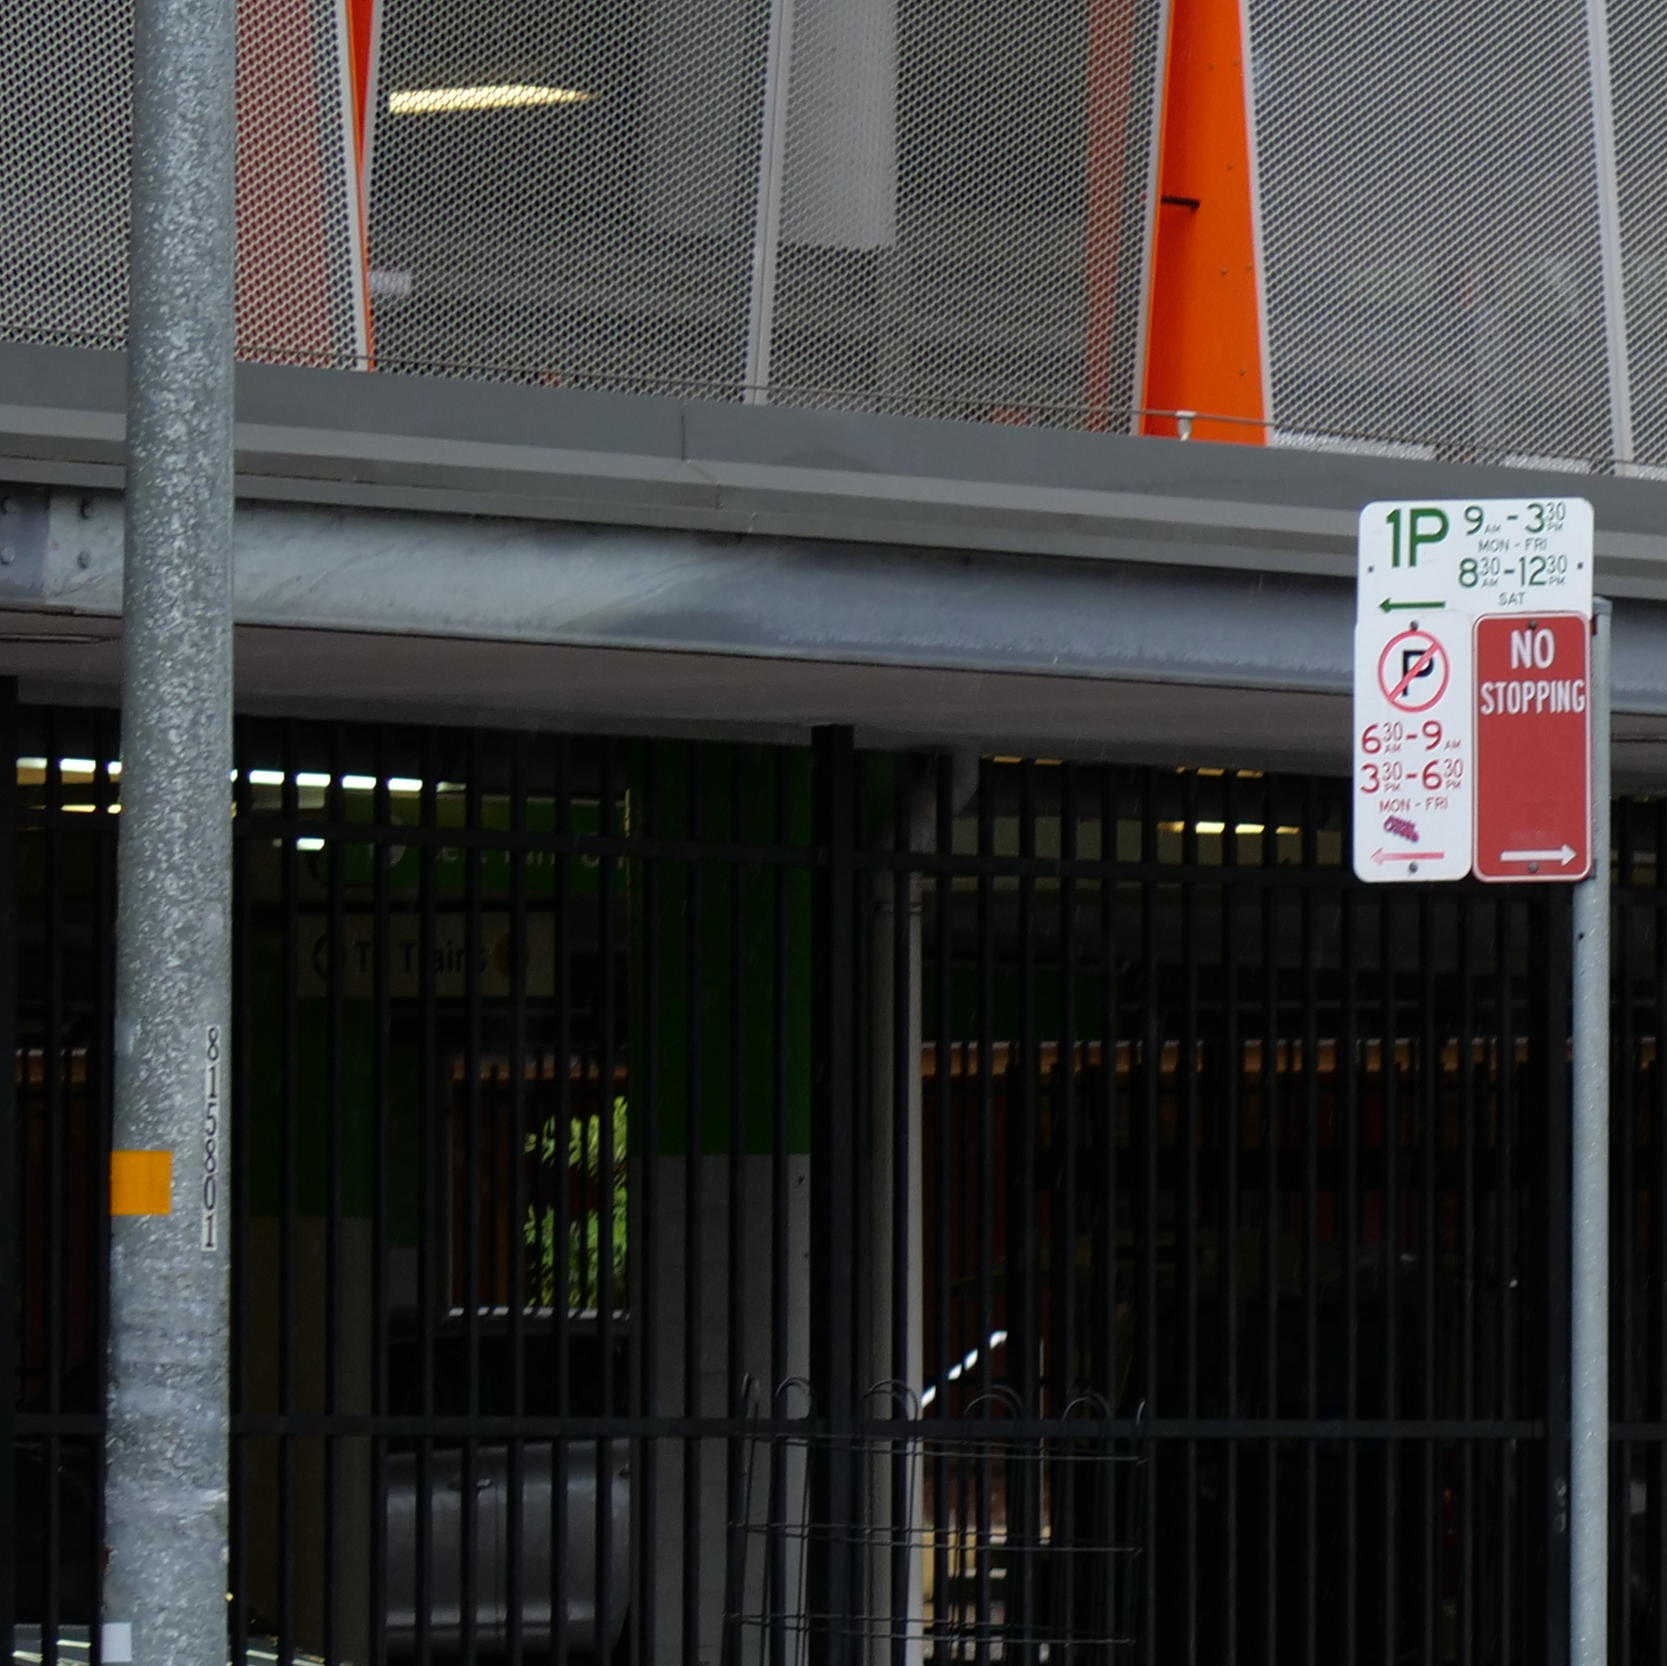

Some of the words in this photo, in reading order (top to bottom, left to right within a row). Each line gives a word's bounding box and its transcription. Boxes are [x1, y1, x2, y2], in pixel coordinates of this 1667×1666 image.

[1386, 508, 1450, 567] 1P
[1478, 539, 1510, 552] MON
[1525, 537, 1547, 551] FRI
[1498, 592, 1526, 606] SAT
[1511, 628, 1555, 669] NO
[1481, 680, 1586, 715] STOPPING
[1379, 798, 1411, 812] MON
[1426, 797, 1448, 810] FRI
